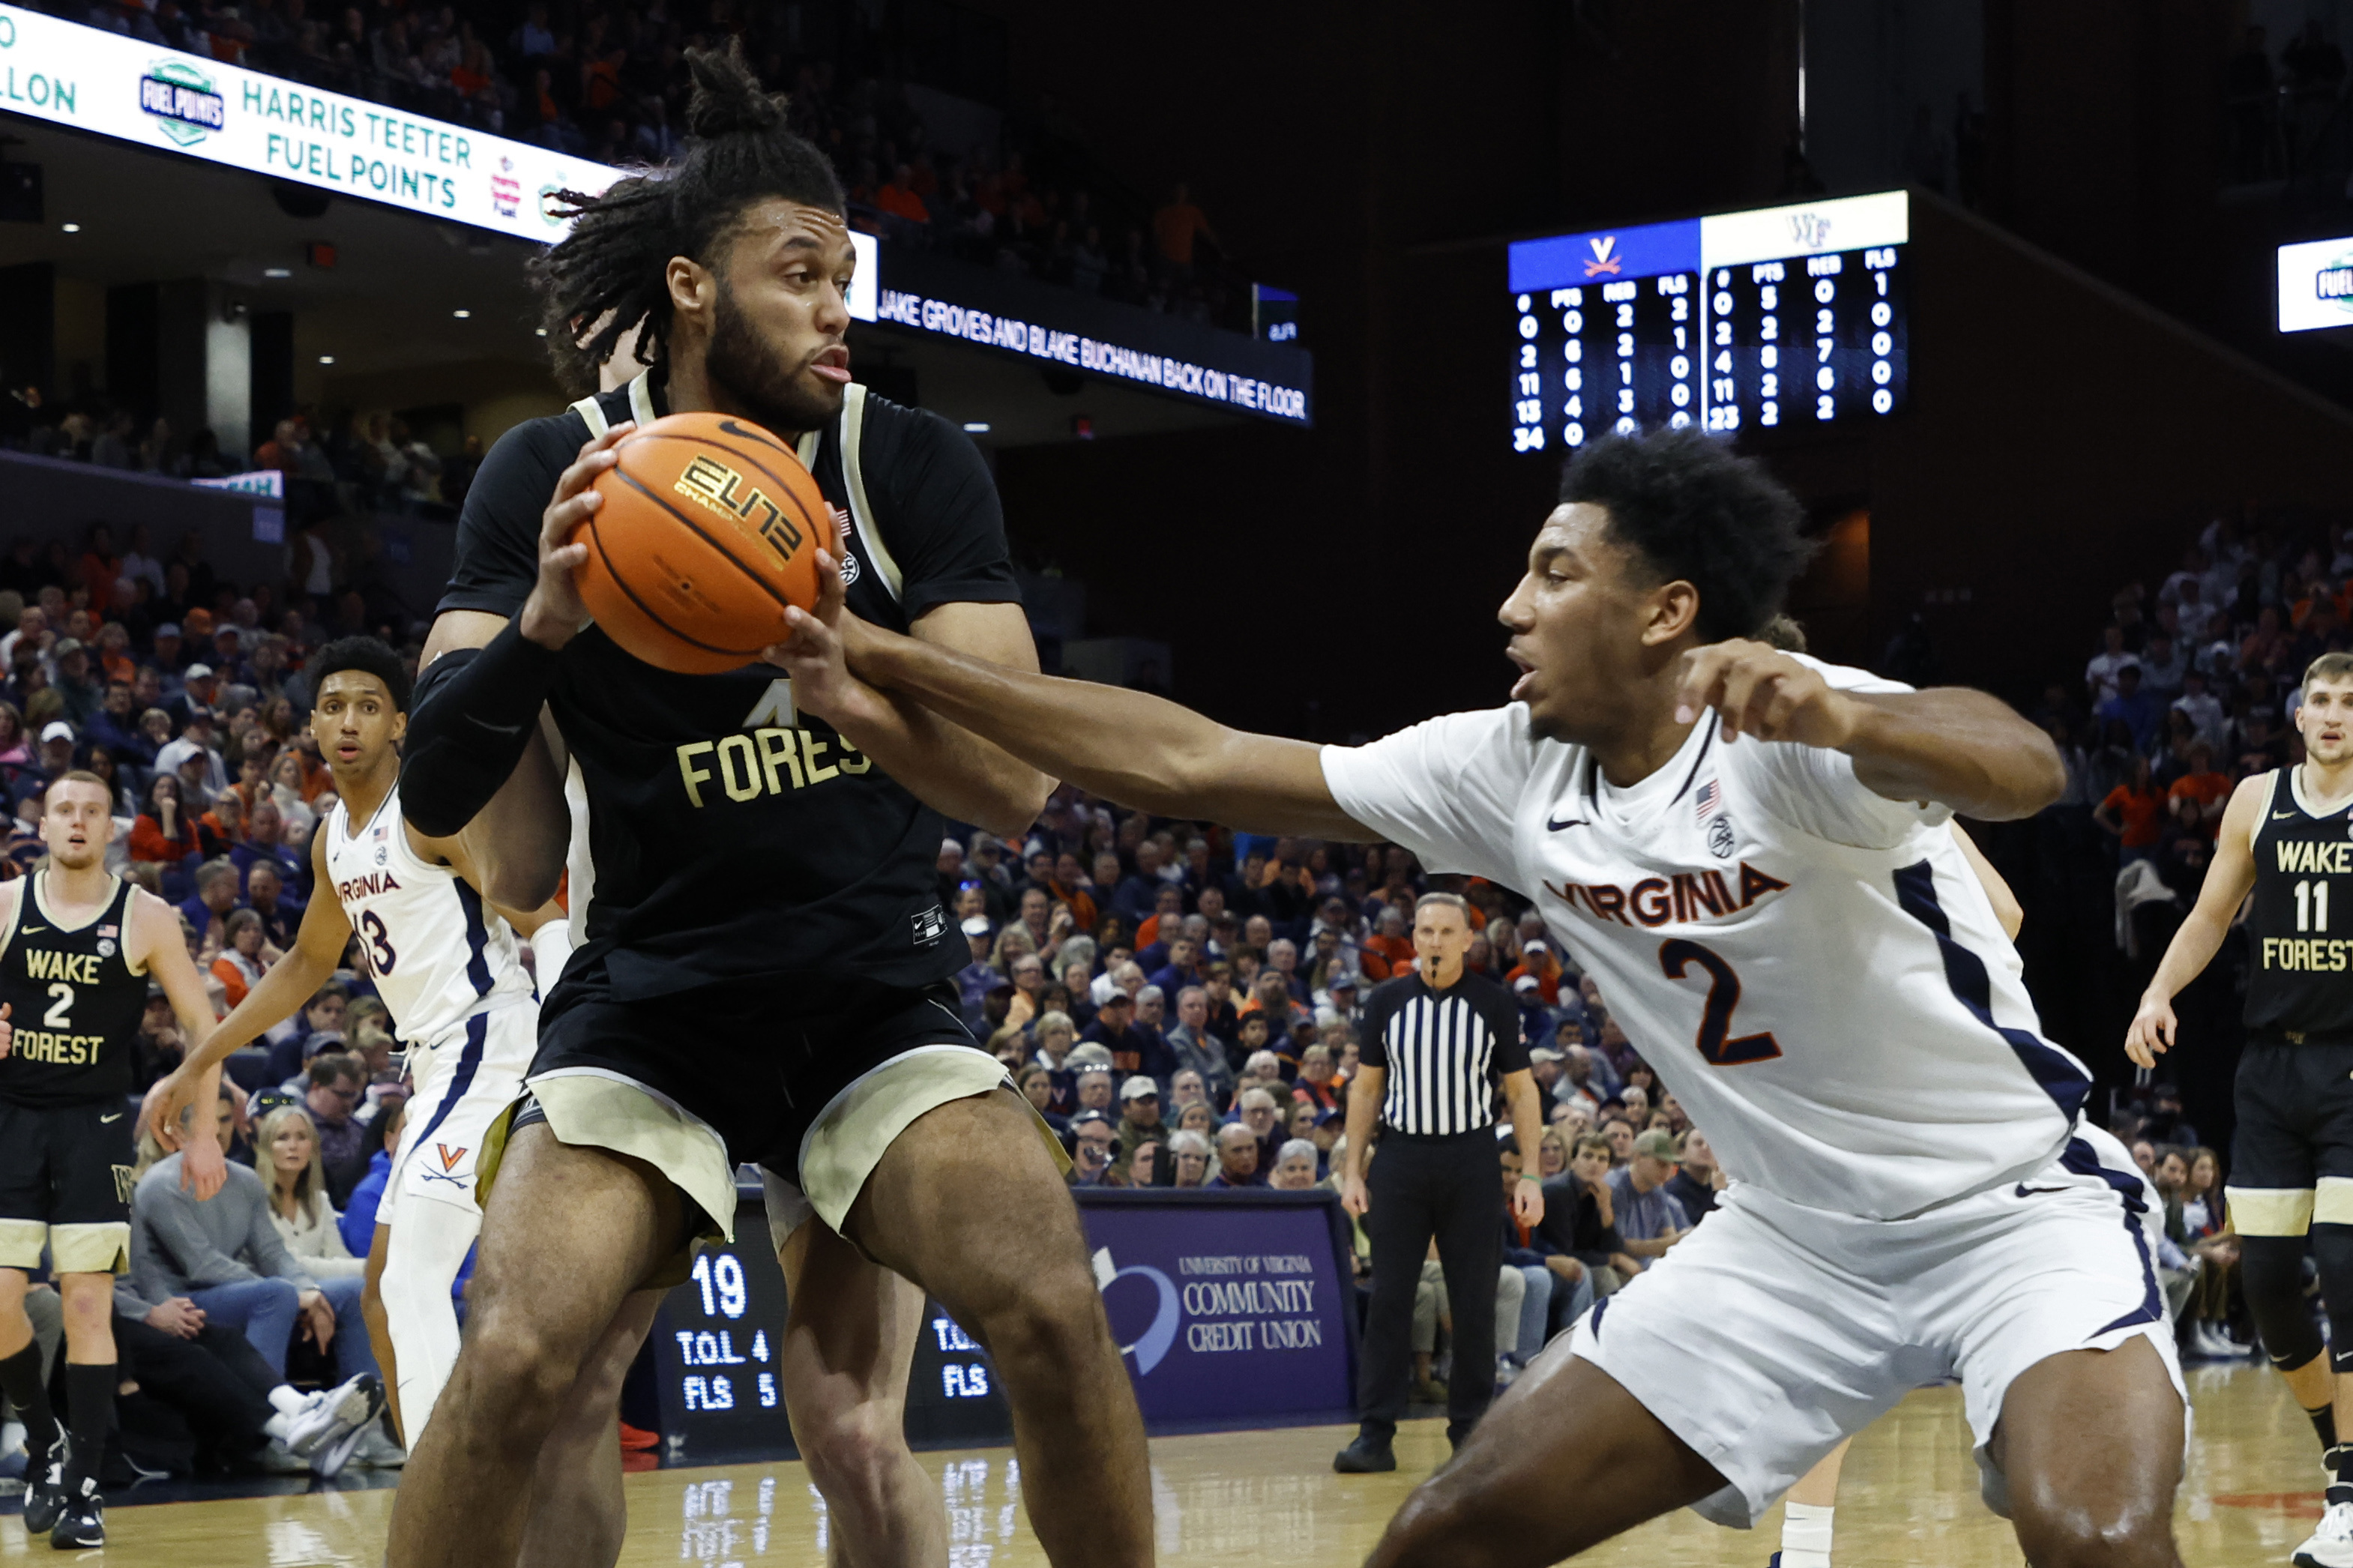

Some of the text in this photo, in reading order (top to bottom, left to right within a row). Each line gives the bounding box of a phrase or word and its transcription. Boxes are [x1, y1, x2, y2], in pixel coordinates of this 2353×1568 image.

[0, 65, 76, 115] LON
[242, 79, 471, 169] HARRIS TEETER
[268, 132, 457, 209] FUEL POINTS
[1753, 262, 1785, 284] PTS
[1807, 255, 1842, 277] REB
[1865, 247, 1896, 270] FLS
[1551, 288, 1582, 309] PTS
[1603, 280, 1636, 302] REB
[1657, 274, 1688, 295] FLS
[1713, 272, 1887, 316] 0 5 0 1
[1519, 297, 1688, 339] 0 0 2 2
[1715, 302, 1891, 345] 2 2 2 0
[878, 289, 1306, 420] JAKE GROVES AND BLAKE BUCHANAN BACK ON THE FLOOR
[1520, 326, 1686, 368] 2 6 2 1
[1714, 331, 1892, 374] 4 8 7 0
[1519, 355, 1690, 396] 11 6 1 0
[1712, 360, 1891, 402] 11 2 6 0
[1516, 383, 1690, 424] 13 4 3 0
[1708, 389, 1892, 430] 23 2 2 0
[1513, 426, 1545, 452] 34
[1564, 422, 1584, 446] 0
[680, 453, 804, 562] ELITE
[676, 728, 872, 808] FORES
[2277, 839, 2353, 874] WAKE
[337, 869, 402, 902] IRGINIA
[2294, 880, 2329, 932] 11
[25, 947, 104, 985] WAKE
[43, 982, 76, 1030] 2
[1658, 938, 1784, 1067] 2
[12, 1028, 105, 1066] FOREST
[1178, 1255, 1313, 1275] UNIVERSITY OF VIRGINIA
[691, 1254, 747, 1318] 19
[1183, 1280, 1315, 1315] COMMUNITY
[752, 1330, 770, 1363] 4
[1187, 1319, 1322, 1352] CREDIT UNION
[683, 1373, 777, 1410] FLS 5
[942, 1363, 988, 1398] FLS
